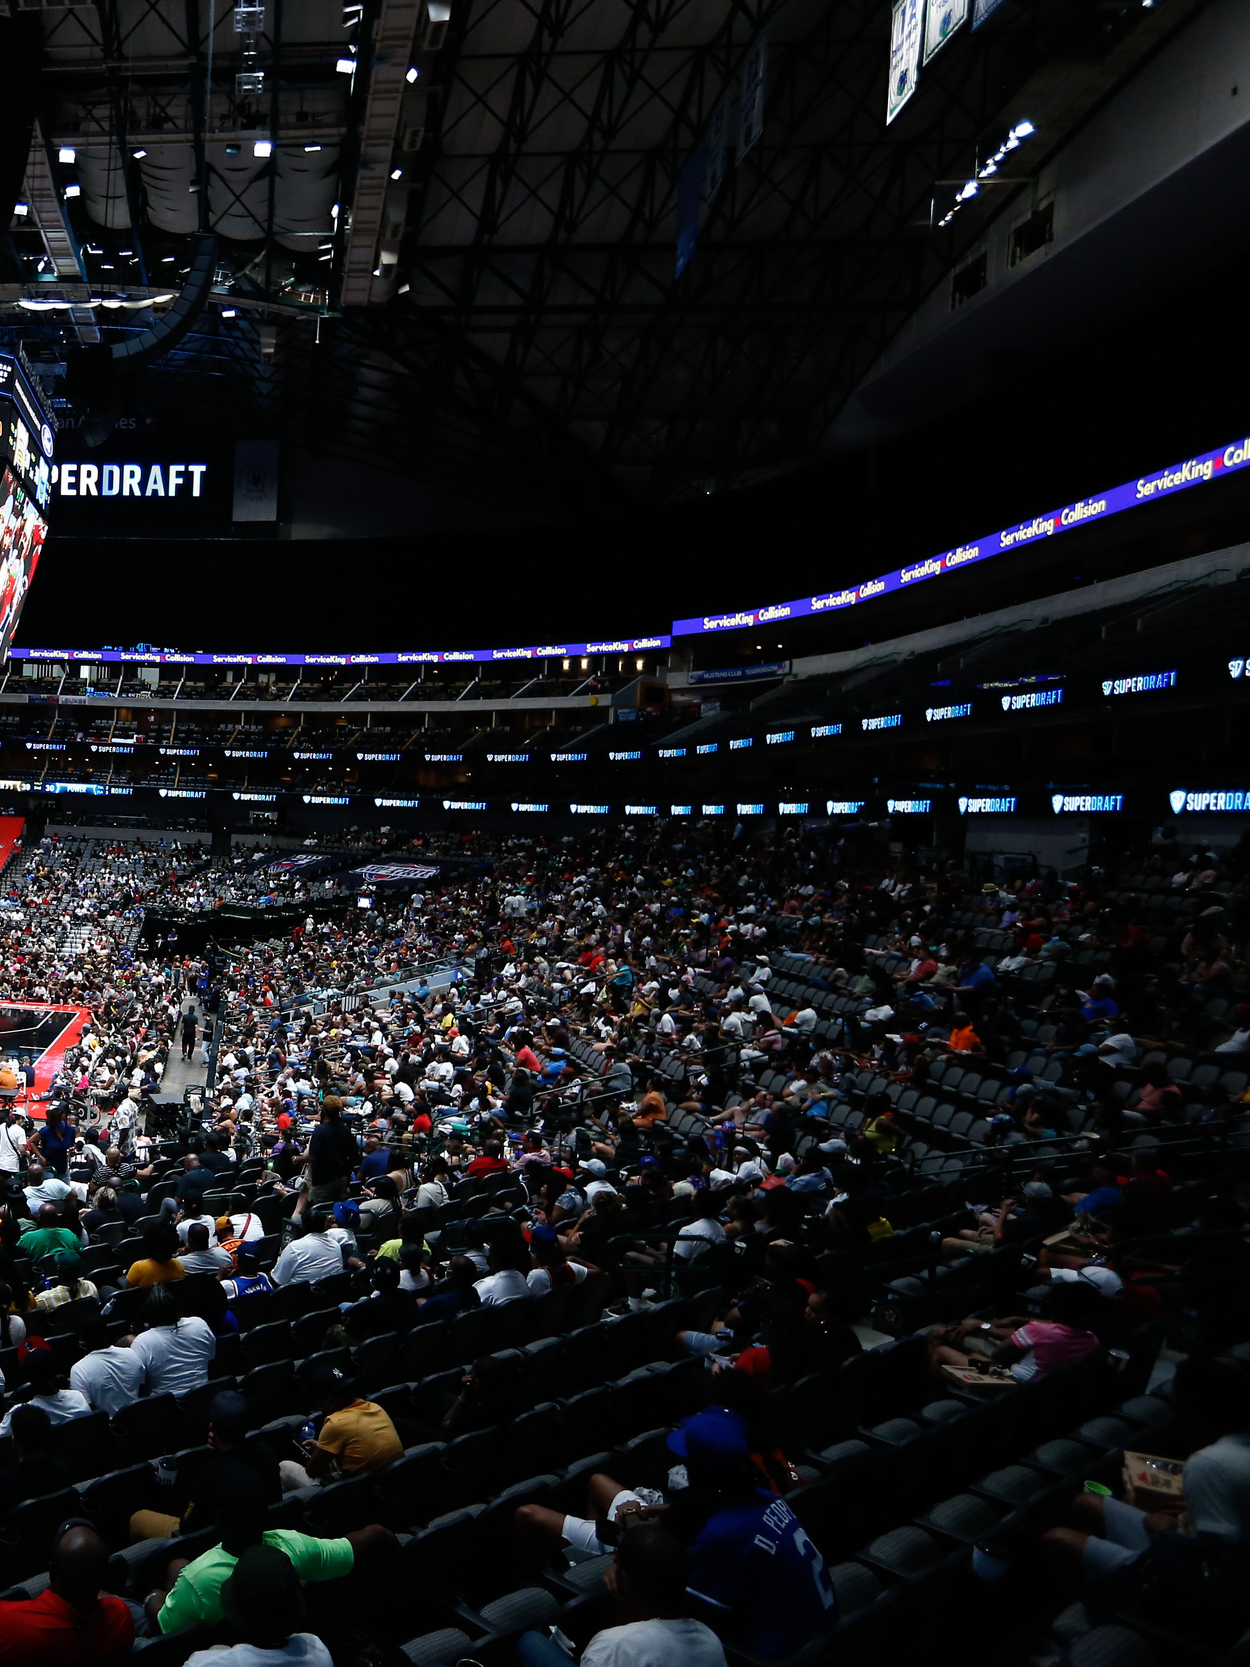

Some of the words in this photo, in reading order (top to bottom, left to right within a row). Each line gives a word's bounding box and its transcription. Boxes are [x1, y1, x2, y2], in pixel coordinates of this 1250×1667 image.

[1136, 460, 1213, 498] ServiceKing
[1000, 518, 1054, 547] ServiceKing
[1061, 500, 1105, 525] Collision
[901, 559, 941, 583] ServiceKing
[946, 546, 978, 566] Collision
[811, 591, 856, 610] ServiceKing
[860, 580, 884, 597] Collision
[703, 613, 754, 629] ServiceKing
[759, 605, 790, 621] Collision
[586, 642, 628, 652] ServiceKing
[633, 638, 661, 648] Collision
[30, 650, 69, 659] ServiceKing
[121, 653, 160, 662] ServiceKing
[165, 654, 194, 662] Collision
[213, 655, 252, 664] ServiceKing
[398, 653, 438, 662] ServiceKing
[444, 652, 474, 660] Collision
[493, 649, 532, 658] ServiceKing
[537, 647, 566, 655] Collision
[305, 655, 346, 665] ServiceKing
[1114, 672, 1175, 694] SUPERDRAFT
[1012, 690, 1061, 709] SUPERDRAFT
[932, 704, 971, 720] SUPERDRAFT
[167, 790, 206, 798] SUPERDRAFT
[311, 796, 349, 804] SUPERDRAFT
[382, 799, 418, 807] SUPERDRAFT
[450, 802, 486, 810] SUPERDRAFT
[967, 798, 1015, 812] SUPERDRAFT
[1062, 796, 1122, 811] SUPERDRAFT
[753, 1534, 779, 1555] D.
